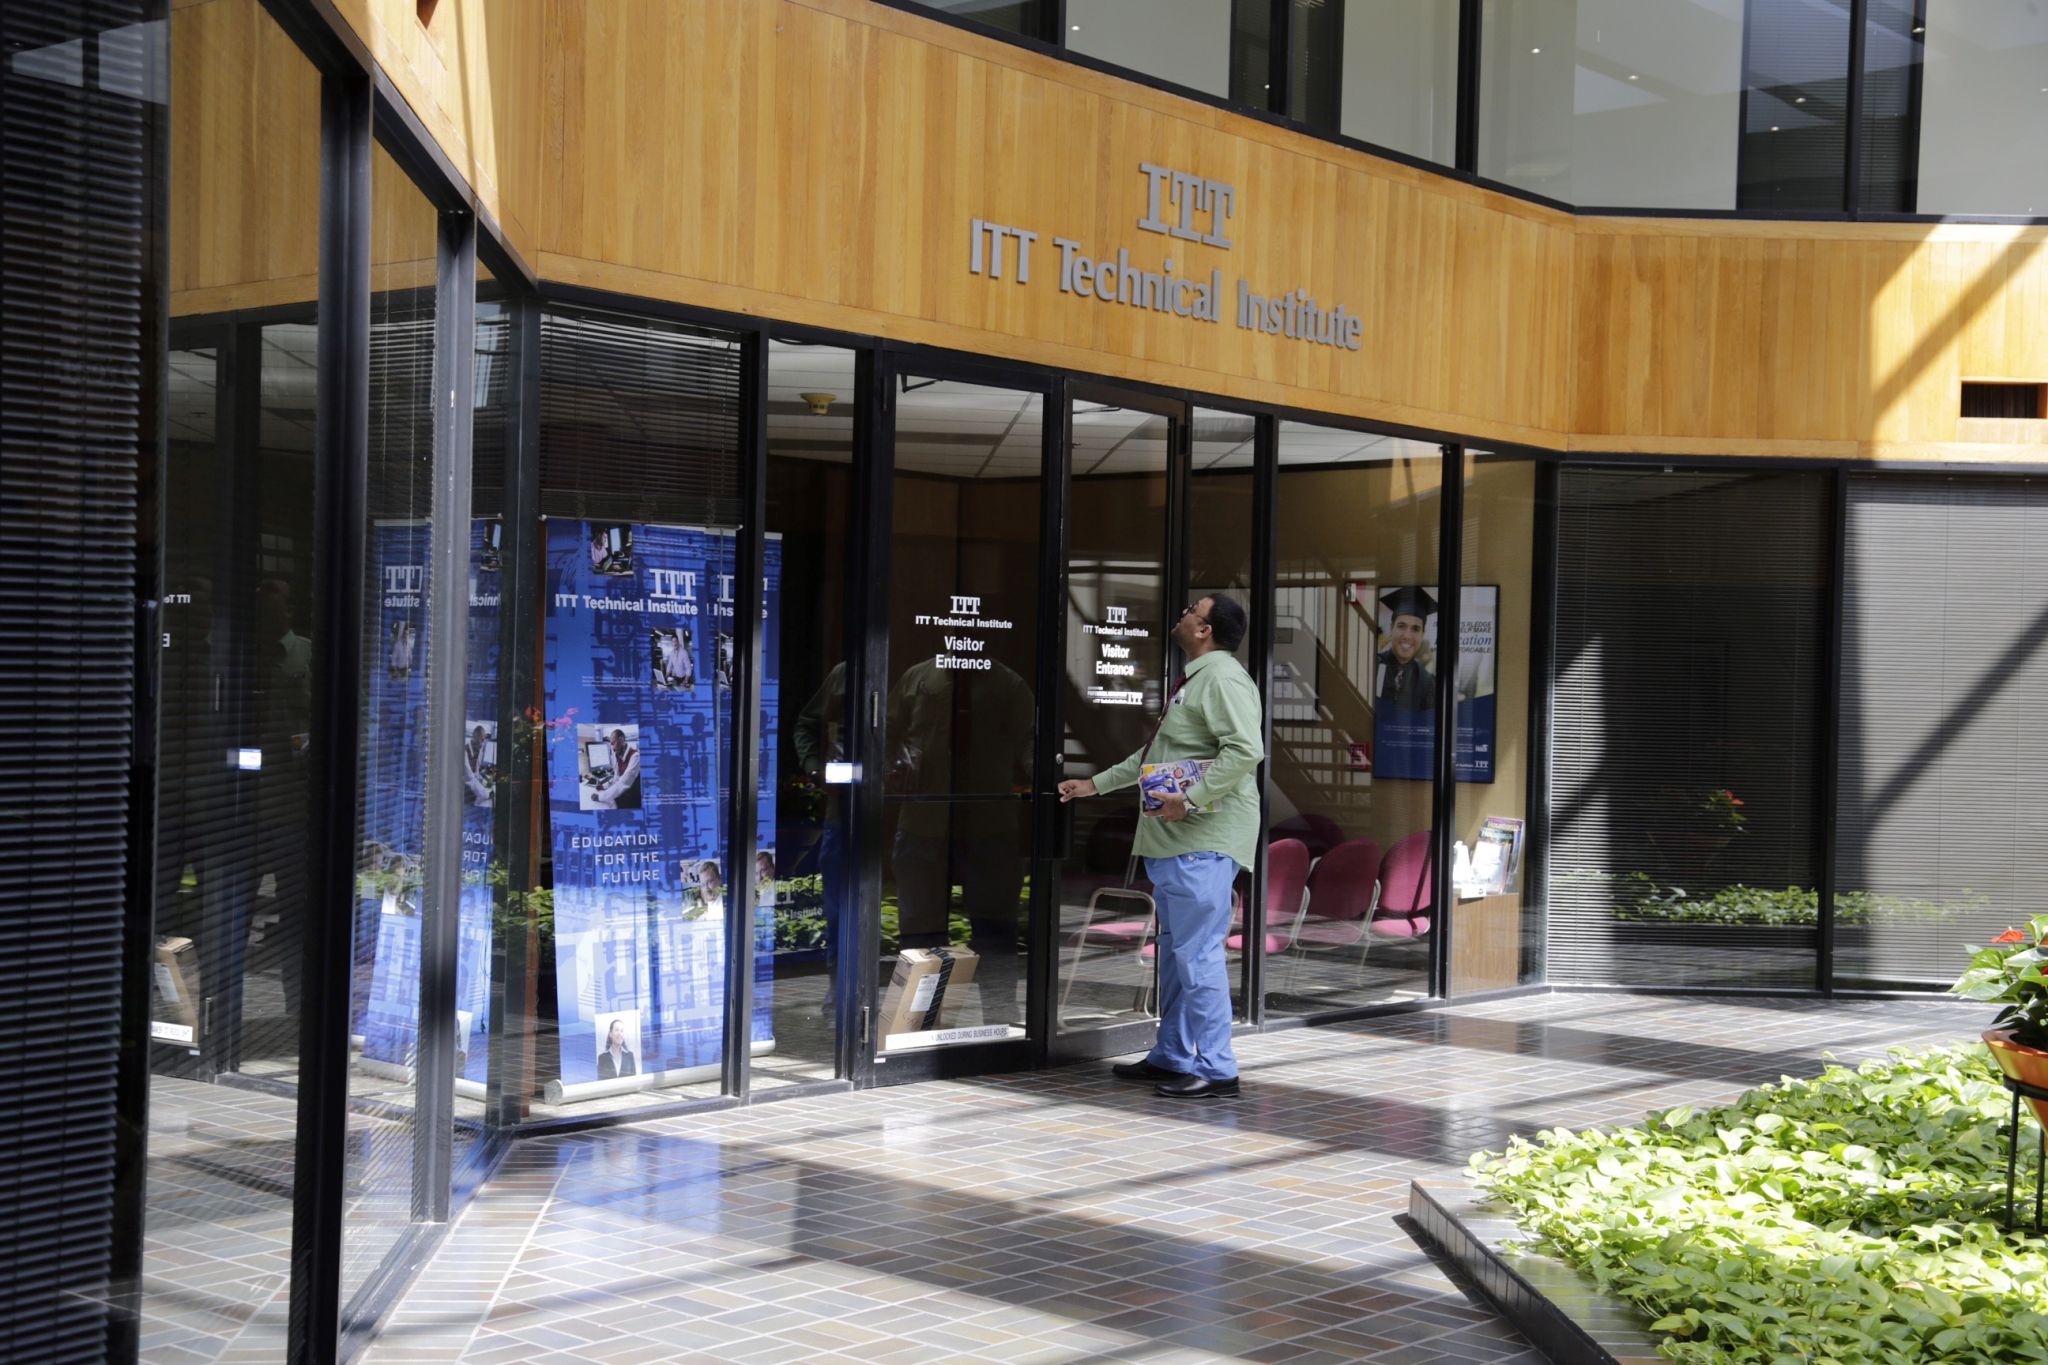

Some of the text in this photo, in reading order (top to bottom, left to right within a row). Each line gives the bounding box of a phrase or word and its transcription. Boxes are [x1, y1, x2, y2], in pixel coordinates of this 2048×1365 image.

[1138, 162, 1234, 249] ITT
[970, 218, 1363, 351] ITT Technical Institute
[650, 568, 697, 600] ITT
[555, 594, 579, 608] ITT
[583, 595, 644, 612] Technical
[648, 599, 698, 615] Institute
[949, 596, 981, 615] ITT
[915, 615, 1013, 629] ITT Technical Institute
[1106, 606, 1127, 624] ITT
[1083, 624, 1149, 637] ITT Technical Institute
[944, 636, 985, 651] Visitor
[1101, 643, 1130, 658] Visitor
[935, 654, 992, 670] Entrance
[1095, 660, 1135, 676] Entrance
[571, 834, 658, 848] EDUCATION
[595, 852, 660, 865] FOR THE
[602, 870, 660, 883] FUTURE
[973, 1029, 993, 1038] BUSINESS
